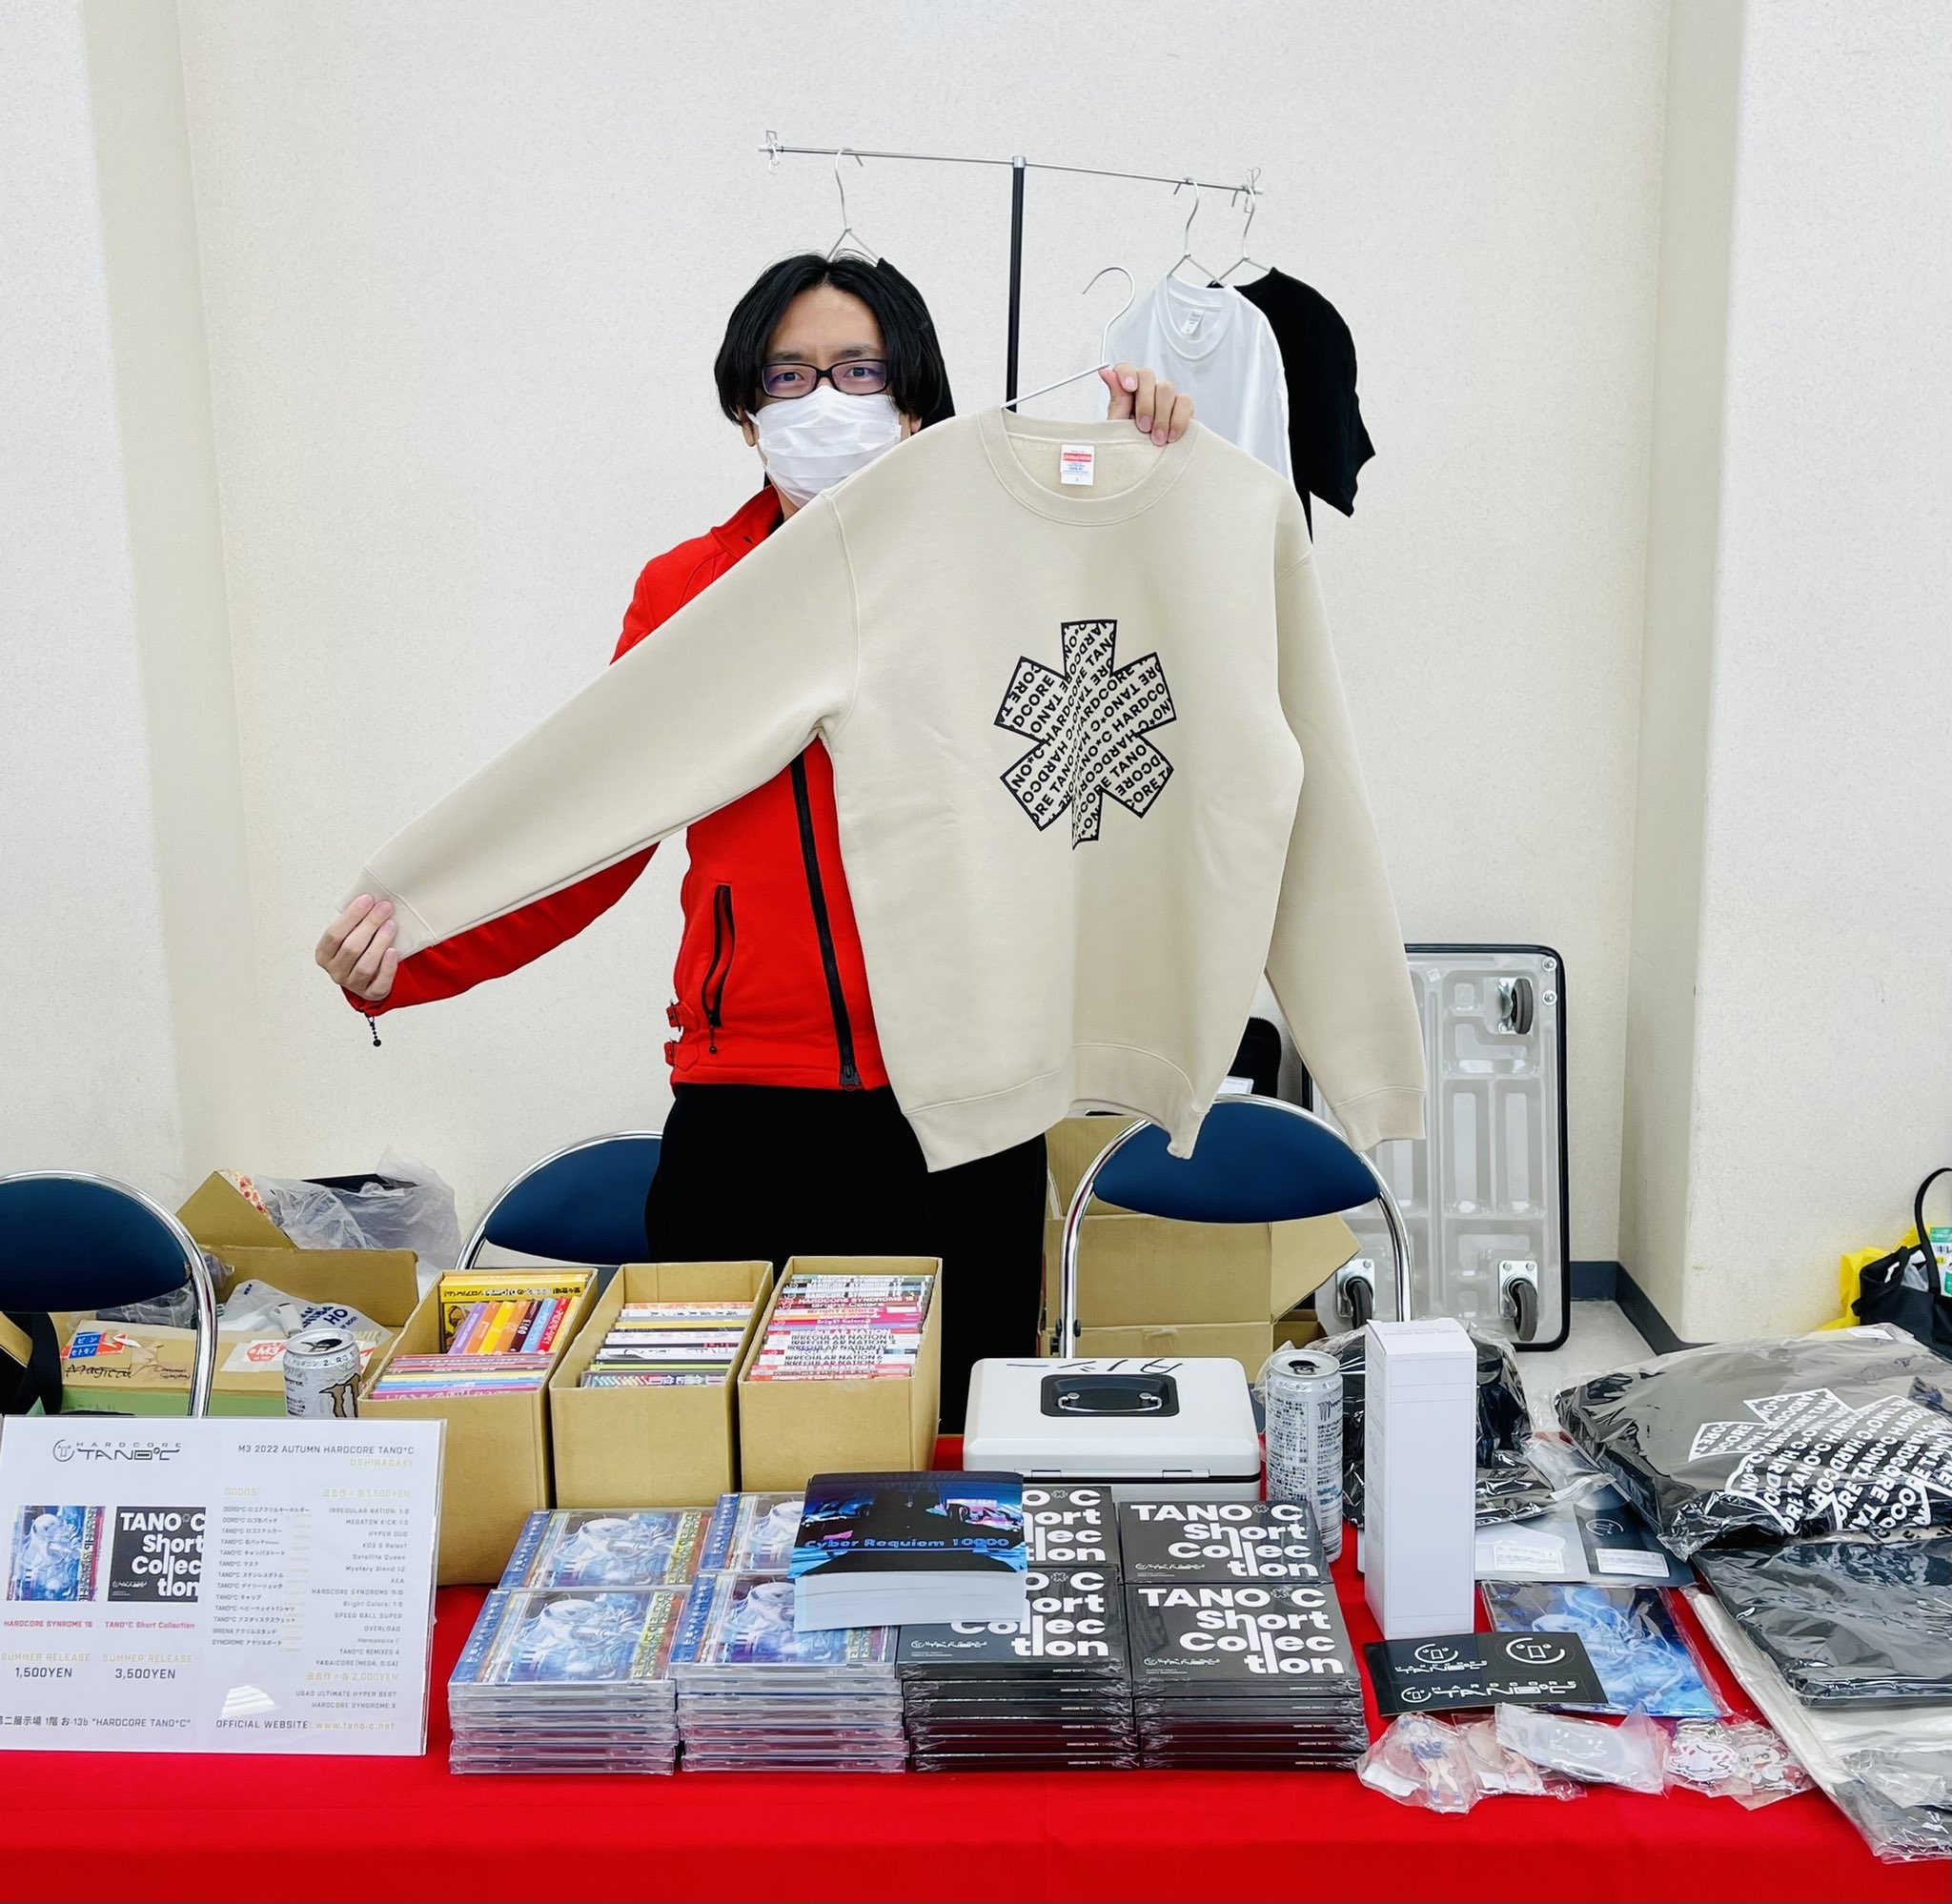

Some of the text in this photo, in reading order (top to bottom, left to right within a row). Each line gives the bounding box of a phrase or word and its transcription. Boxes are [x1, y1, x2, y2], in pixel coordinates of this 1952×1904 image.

[238, 1445, 252, 1453] M3
[254, 1445, 279, 1453] 2022
[281, 1446, 320, 1454] AUTUMN
[1184, 1522, 1309, 1541] Short
[142, 1534, 204, 1553] Short
[1168, 1539, 1312, 1559] Collec
[132, 1555, 202, 1575] Collec
[4, 1620, 44, 1629] HARDCORE
[158, 1621, 195, 1630] Collection
[1195, 1609, 1332, 1631] Short
[1179, 1631, 1335, 1653] Collec
[1, 1653, 91, 1662] SUMMER RELEASE
[102, 1654, 193, 1663] SUMMER RELEASE
[15, 1668, 72, 1679] 1,500YEN
[114, 1669, 176, 1680] 3,500YEN
[215, 1720, 260, 1729] OFFICIAL
